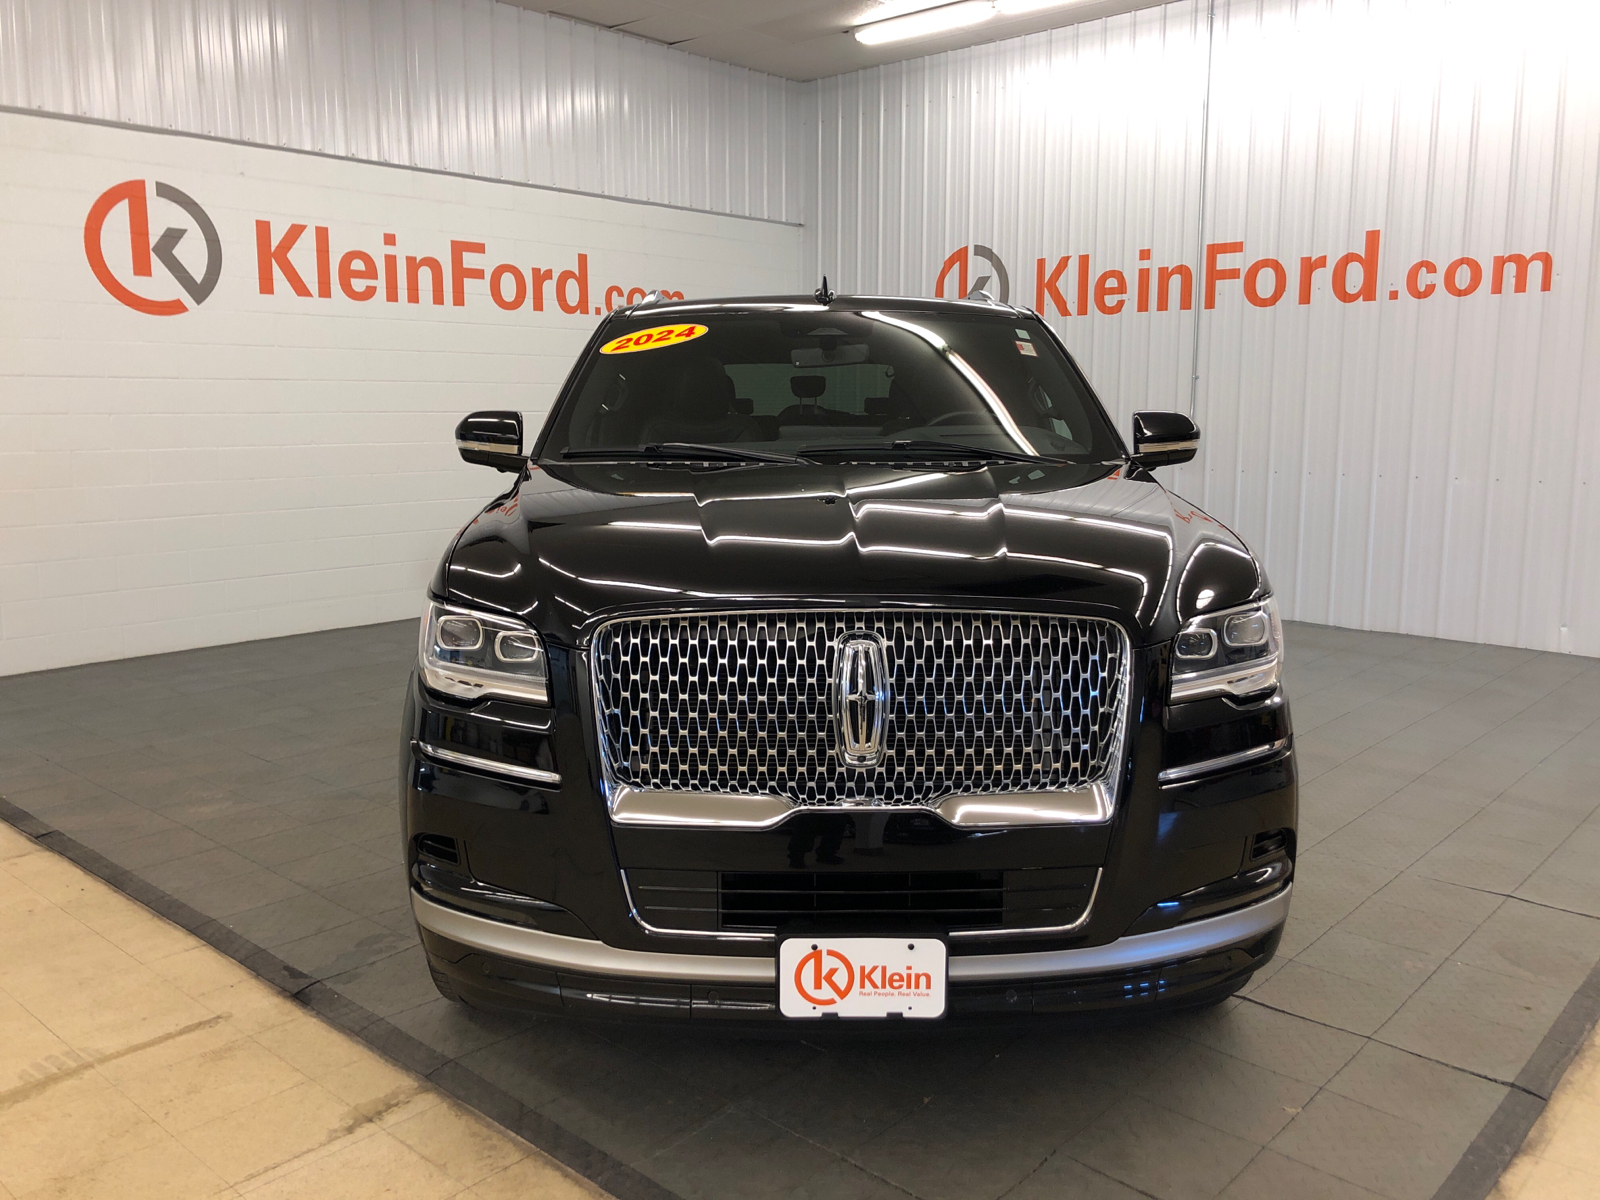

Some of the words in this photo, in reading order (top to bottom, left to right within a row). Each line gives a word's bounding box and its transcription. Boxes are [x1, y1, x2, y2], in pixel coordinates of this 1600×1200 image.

[1035, 229, 1553, 317] KleinFord.com
[610, 325, 696, 352] 2024
[859, 965, 932, 990] Klein
